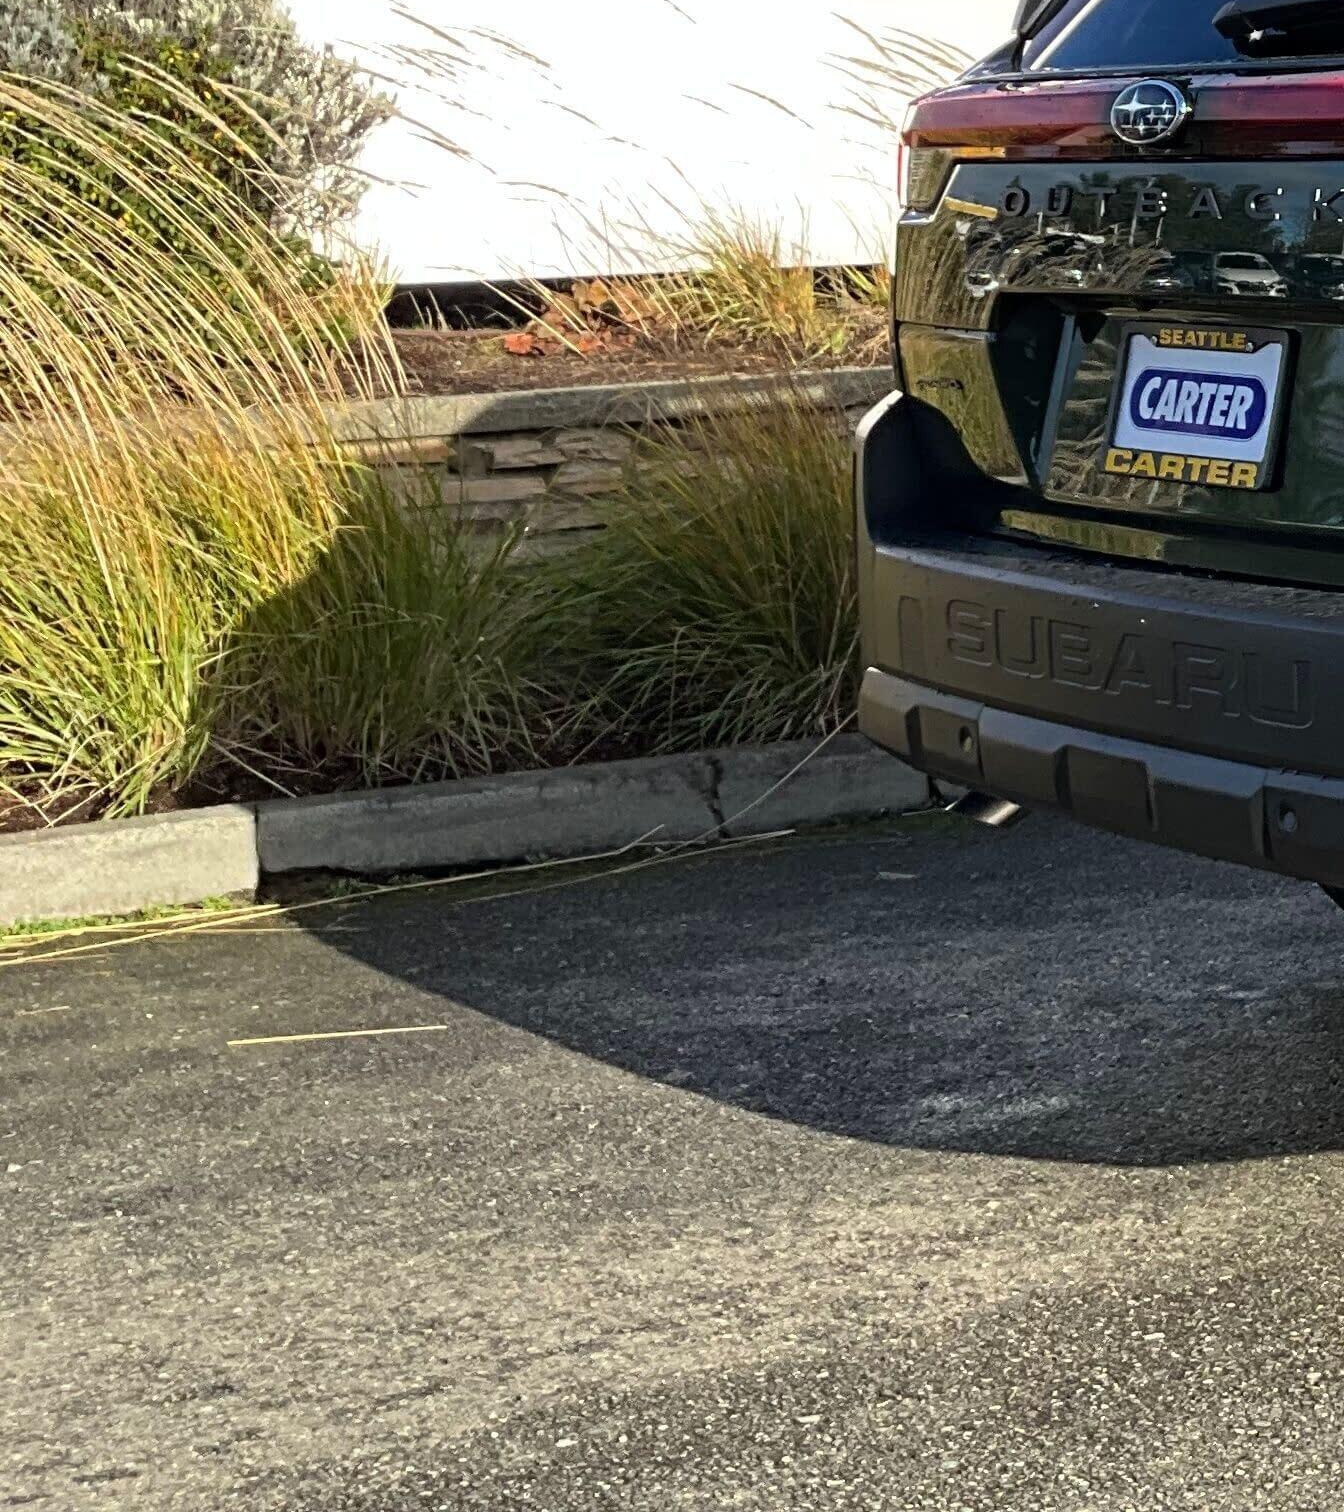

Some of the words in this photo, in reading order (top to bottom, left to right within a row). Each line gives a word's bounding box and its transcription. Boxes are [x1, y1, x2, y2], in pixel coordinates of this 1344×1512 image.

[1159, 328, 1248, 350] SEATTLE
[1138, 376, 1254, 430] CARTER
[1104, 448, 1258, 488] CARTER
[946, 598, 1314, 729] SUBARU
